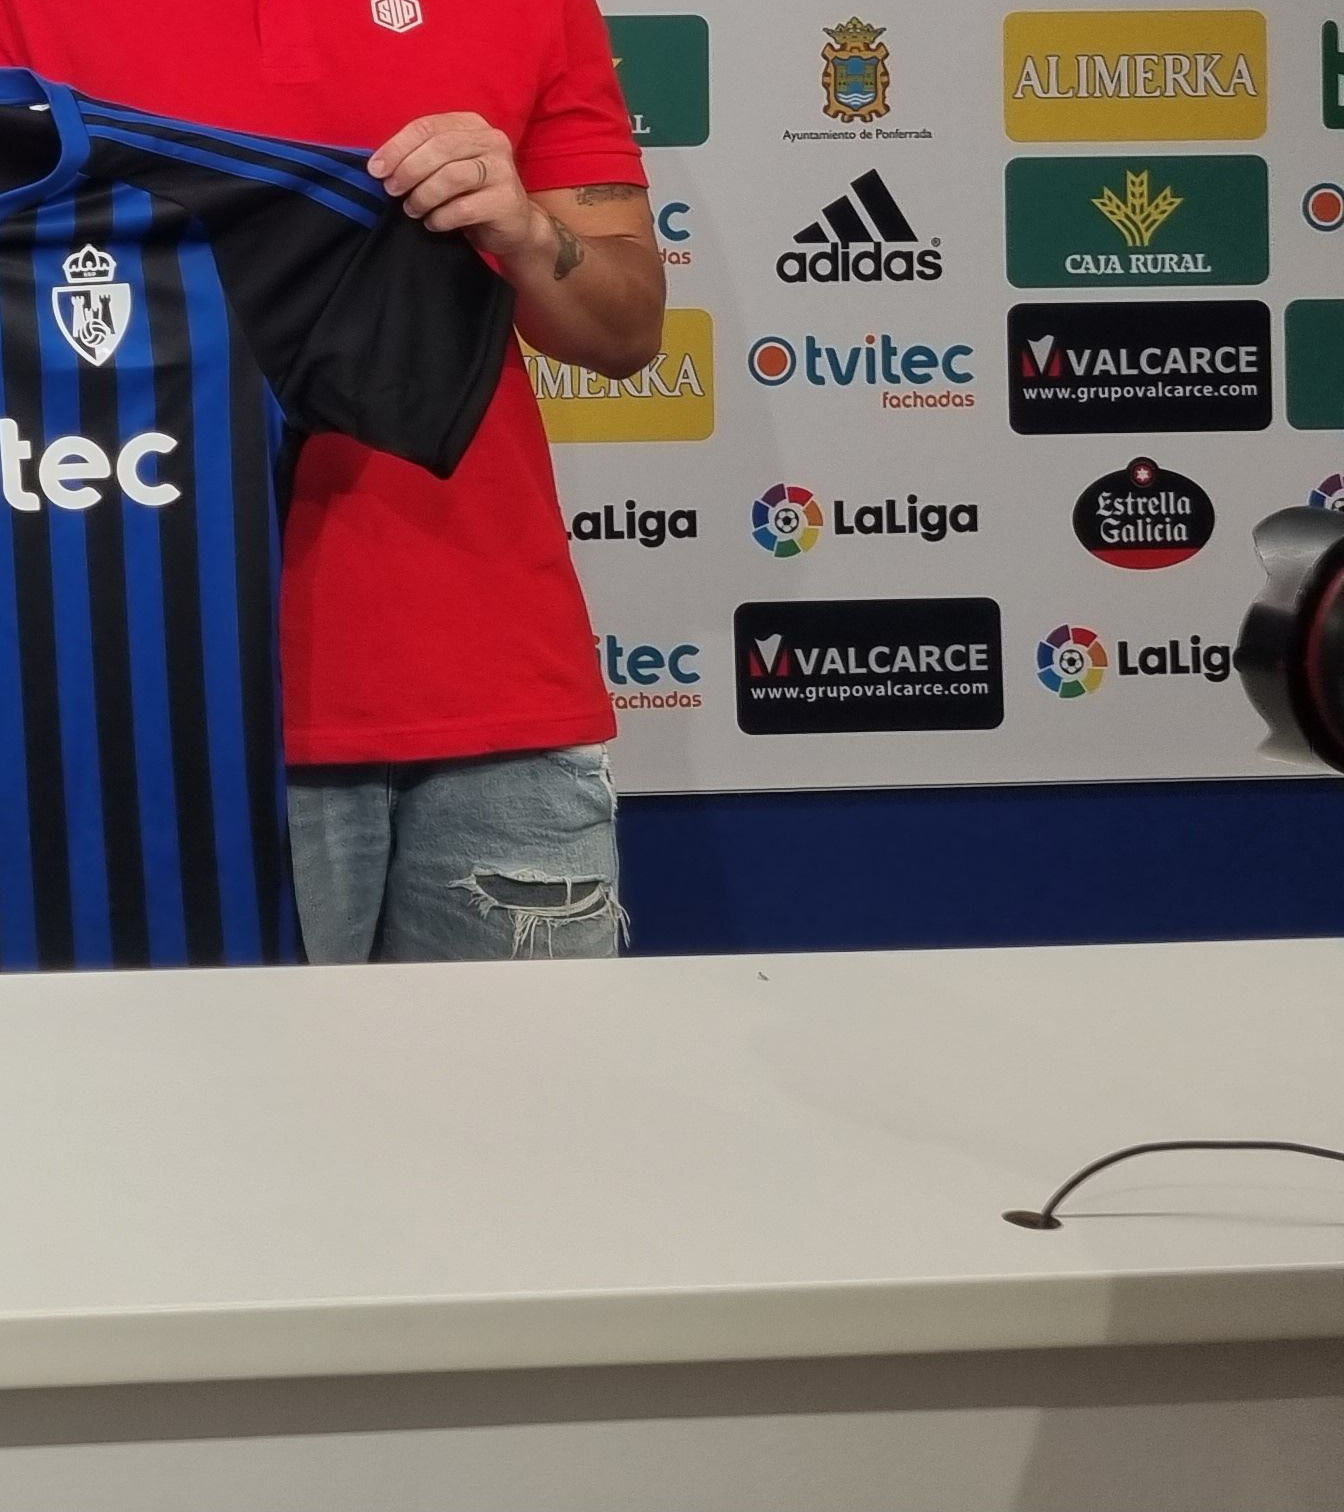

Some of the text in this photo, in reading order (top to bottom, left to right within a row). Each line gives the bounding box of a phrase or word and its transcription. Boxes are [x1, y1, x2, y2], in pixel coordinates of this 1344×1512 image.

[1013, 53, 1259, 99] ALIMERKA
[776, 241, 942, 283] adidas
[1065, 254, 1211, 275] CAJA RURAL
[806, 335, 973, 385] tvitec
[1067, 347, 1257, 375] VALCARCE
[883, 391, 974, 408] fachadas
[1023, 382, 1257, 402] www.grupovalcarce.com
[834, 495, 978, 542] LaLiga
[1096, 492, 1191, 516] Estrella
[566, 499, 698, 548] aLiga
[1101, 518, 1188, 543] Galicia
[795, 644, 988, 675] VALCARCE
[1118, 635, 1231, 682] LaLig
[751, 681, 988, 702] www.grupovalcarce.com
